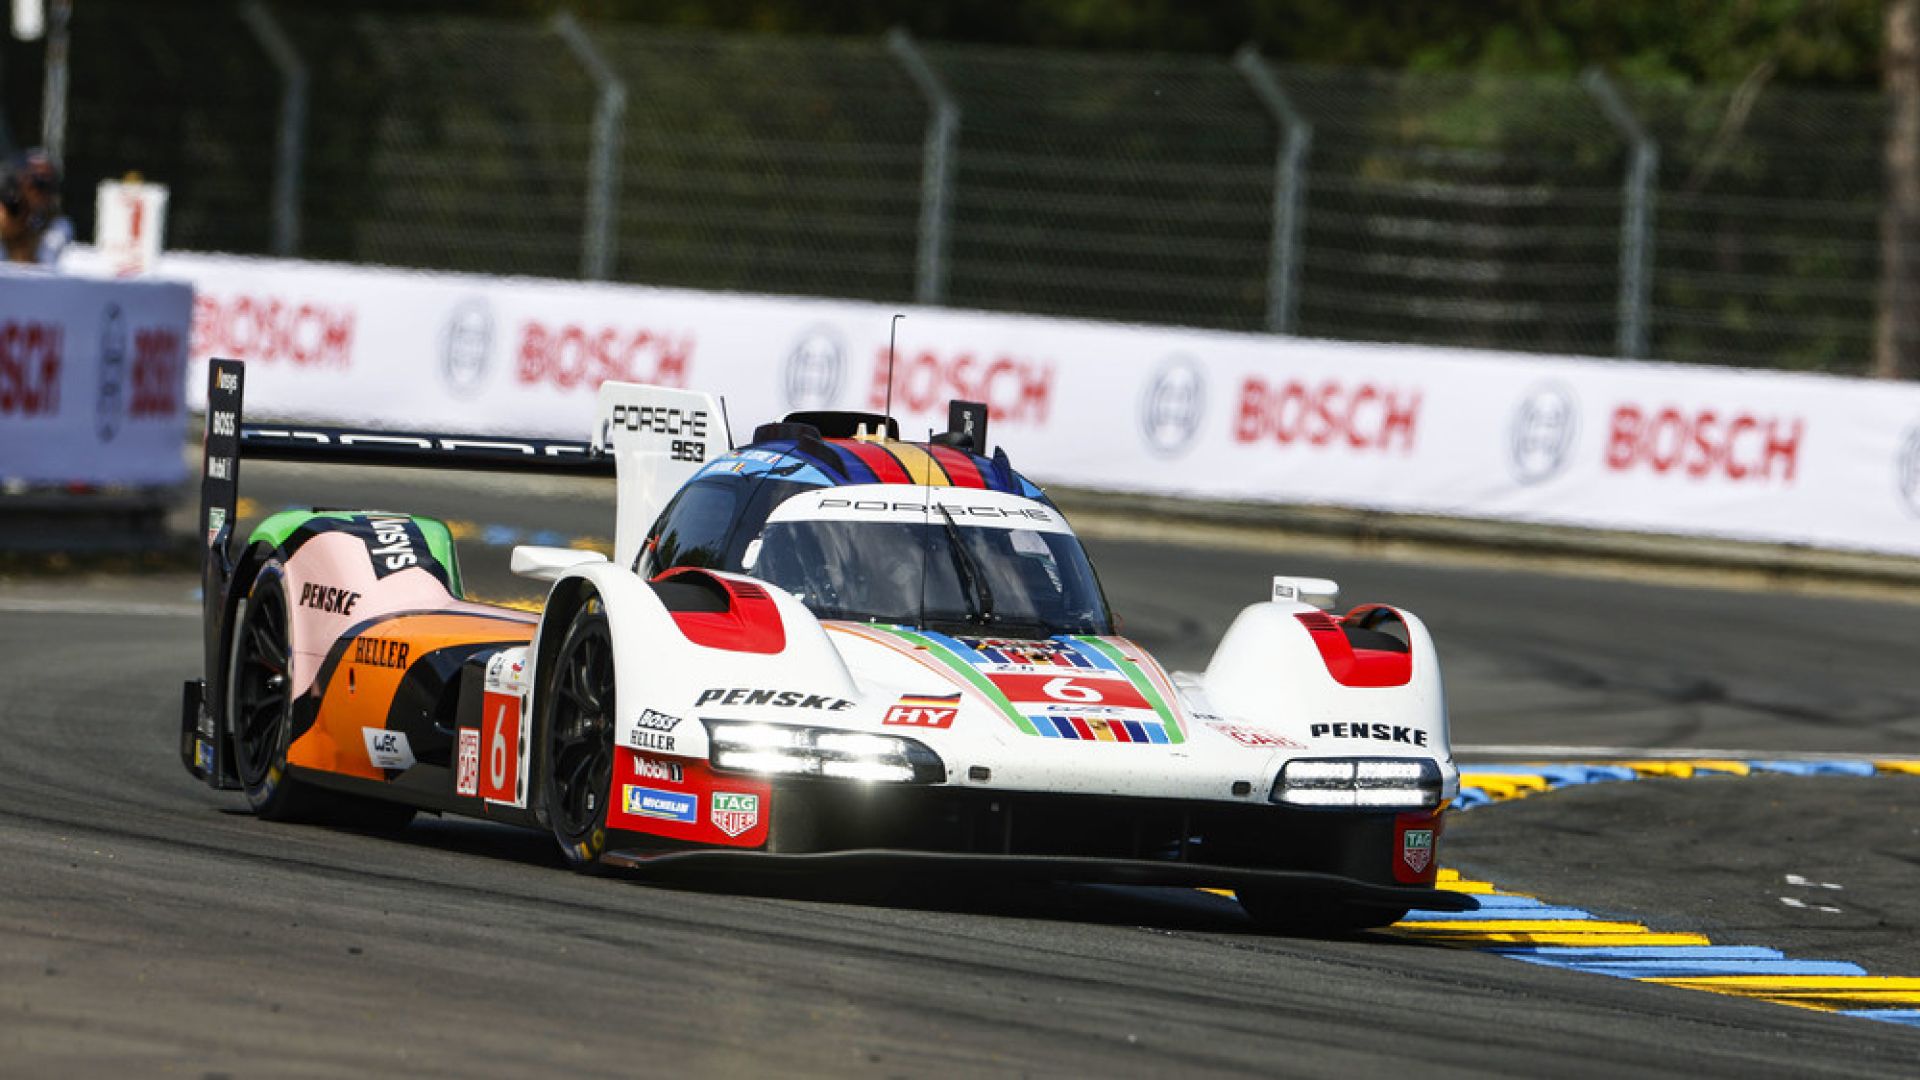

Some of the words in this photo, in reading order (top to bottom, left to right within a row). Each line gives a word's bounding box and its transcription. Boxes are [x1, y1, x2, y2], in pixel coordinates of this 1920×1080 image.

[516, 319, 698, 393] BOSCH
[868, 345, 1056, 430] BOSCH
[213, 410, 236, 436] BOSS
[612, 405, 708, 437] PORSCHE
[1233, 376, 1424, 453] BOSCH
[670, 440, 705, 463] 963
[1604, 404, 1806, 484] BOSCH
[818, 498, 1053, 522] PORSCHE
[299, 581, 363, 616] PENSKE
[354, 635, 411, 670] HELLER
[695, 687, 857, 712] PENSKE
[1043, 677, 1103, 702] 6
[890, 706, 956, 724] HY
[490, 703, 507, 791] 6
[630, 730, 676, 751] HELLER
[1309, 722, 1429, 748] PENSKE
[633, 755, 669, 781] Mobil
[641, 796, 690, 814] MICHELIN
[717, 795, 755, 811] TAG
[712, 811, 758, 834] HEUER
